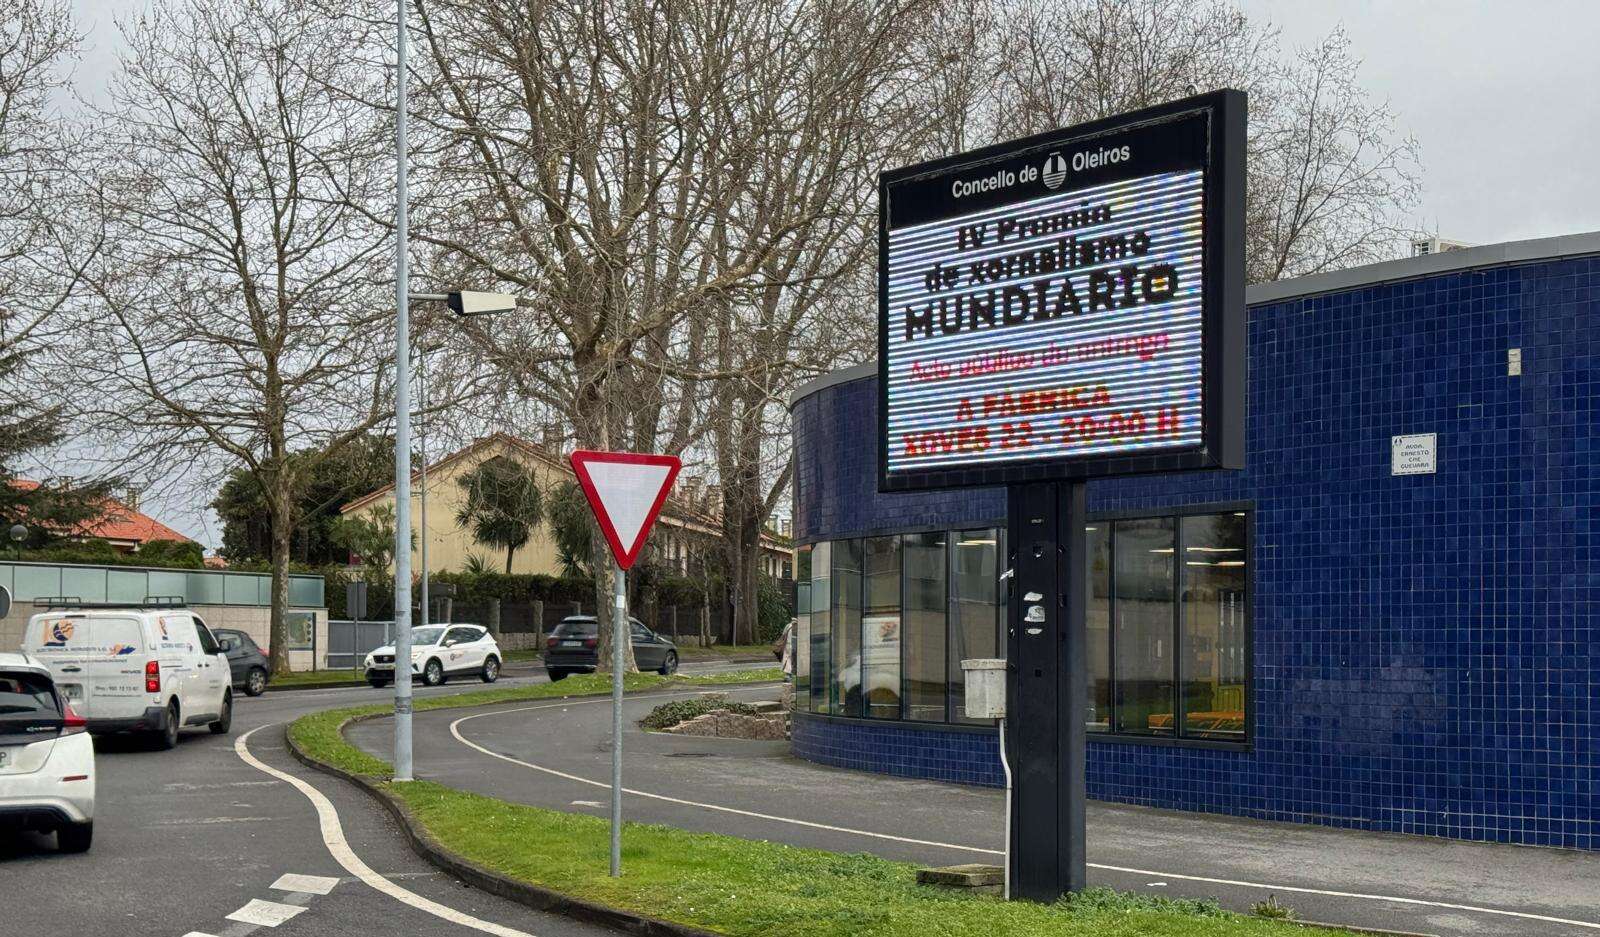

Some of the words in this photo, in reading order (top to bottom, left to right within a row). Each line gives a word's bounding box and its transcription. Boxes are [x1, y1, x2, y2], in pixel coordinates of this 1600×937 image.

[952, 171, 1015, 199] Concello
[1019, 164, 1038, 184] de
[1072, 143, 1131, 172] Oleiros
[958, 224, 988, 251] IV
[998, 201, 1112, 241] Premio
[925, 262, 959, 292] de
[968, 230, 1153, 286] xornalismo
[905, 263, 1179, 342] MUNDIARIO
[956, 399, 974, 421] A
